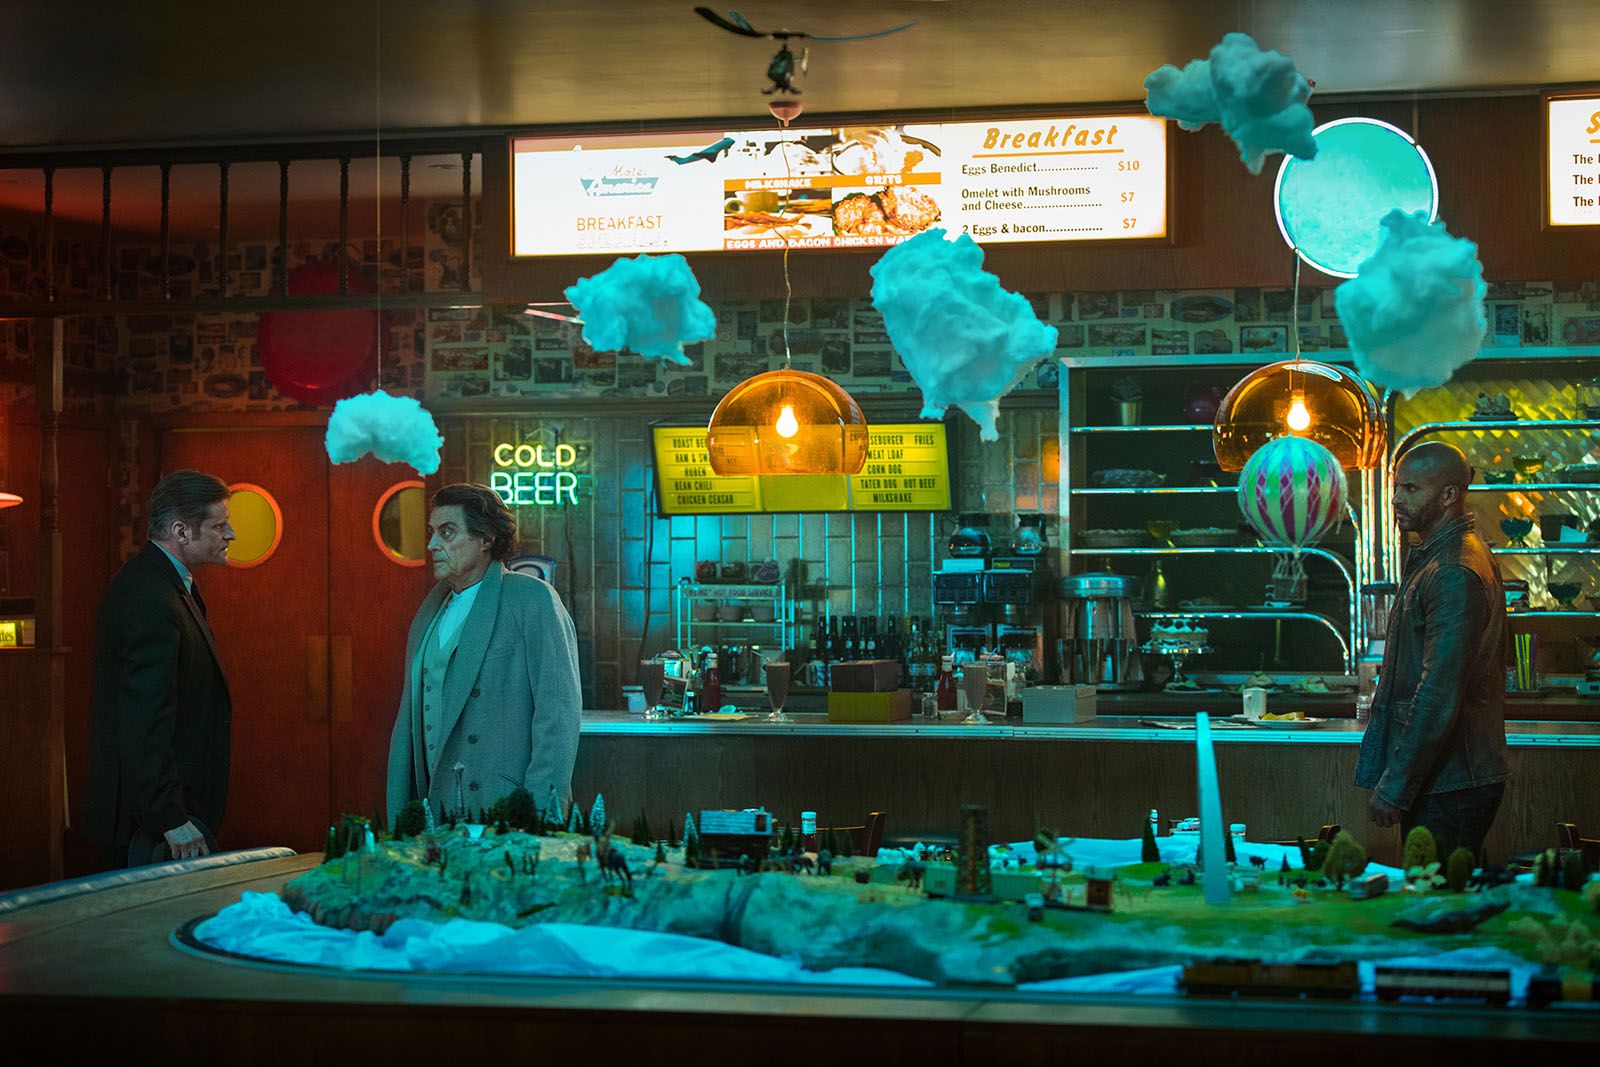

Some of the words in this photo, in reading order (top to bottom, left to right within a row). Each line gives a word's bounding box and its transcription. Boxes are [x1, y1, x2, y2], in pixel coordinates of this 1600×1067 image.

[983, 124, 1118, 149] Breakfast
[1573, 154, 1594, 164] The
[611, 164, 648, 177] Mote
[962, 164, 986, 176] Eggs
[1118, 160, 1140, 171] $10
[745, 179, 812, 189] MILKSHAKE
[865, 174, 903, 185] GRITS
[1573, 174, 1594, 184] The
[962, 188, 998, 199] Omelet
[1002, 187, 1024, 197] with
[1028, 186, 1091, 197] Mushrooms
[1120, 191, 1135, 203] $7
[962, 201, 981, 211] and
[1573, 197, 1594, 207] The
[576, 216, 662, 231] BREAKFAST
[962, 225, 969, 234] 2
[972, 224, 998, 236] Eggs
[1000, 224, 1009, 234] &
[1123, 218, 1137, 229] $7
[727, 239, 756, 249] EGGS
[758, 238, 784, 249] AND
[788, 238, 829, 248] BACON
[834, 236, 883, 247] CHICKEN
[673, 438, 693, 448] ROAST
[914, 435, 934, 445] FRIES
[494, 443, 577, 467] COLD
[675, 453, 689, 463] HAM
[868, 449, 885, 460] MEAT
[888, 449, 904, 460] LOAF
[685, 467, 706, 477] RUBEN
[867, 464, 886, 474] CORN
[889, 464, 902, 474] DOG
[490, 472, 579, 505] BEER
[675, 480, 692, 491] BEAN
[695, 480, 713, 491] CHILI
[861, 479, 881, 489] TATER
[884, 479, 897, 489] DOG
[904, 479, 917, 489] HOT
[920, 479, 936, 489] BEEF
[677, 494, 706, 505] CHICKEN
[709, 494, 734, 505] CEASAR
[873, 493, 912, 503] MILKSHAKE
